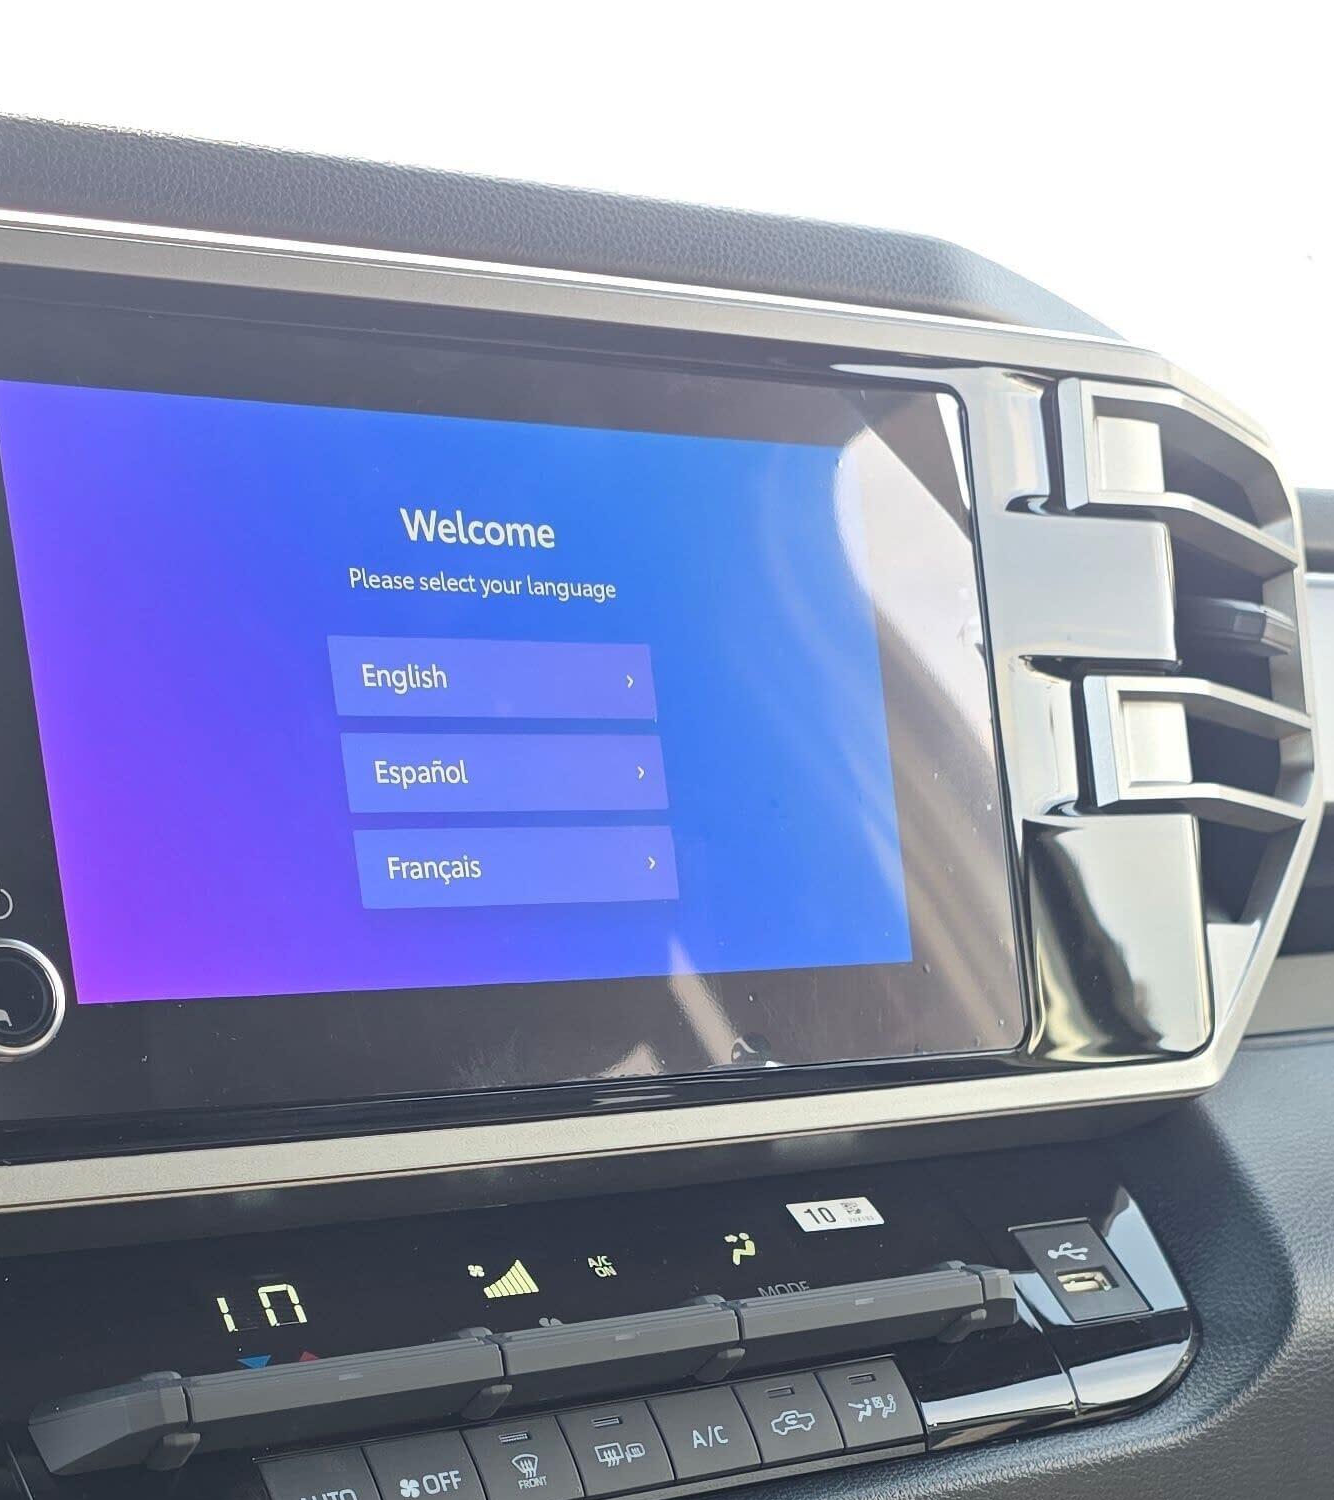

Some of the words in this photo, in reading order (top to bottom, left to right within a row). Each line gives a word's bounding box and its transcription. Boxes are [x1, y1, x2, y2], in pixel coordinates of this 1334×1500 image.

[399, 507, 556, 549] Welcome
[348, 567, 415, 591] Please
[419, 571, 477, 594] select
[479, 577, 523, 599] your
[526, 575, 617, 604] language
[361, 663, 448, 695] English
[374, 759, 469, 790] Español
[387, 854, 482, 886] Français
[803, 1206, 837, 1225] 10
[587, 1255, 613, 1268] A/C
[594, 1265, 618, 1278] ON
[692, 1425, 729, 1449] A/C
[422, 1470, 463, 1495] OFF
[517, 1475, 548, 1491] FRONT
